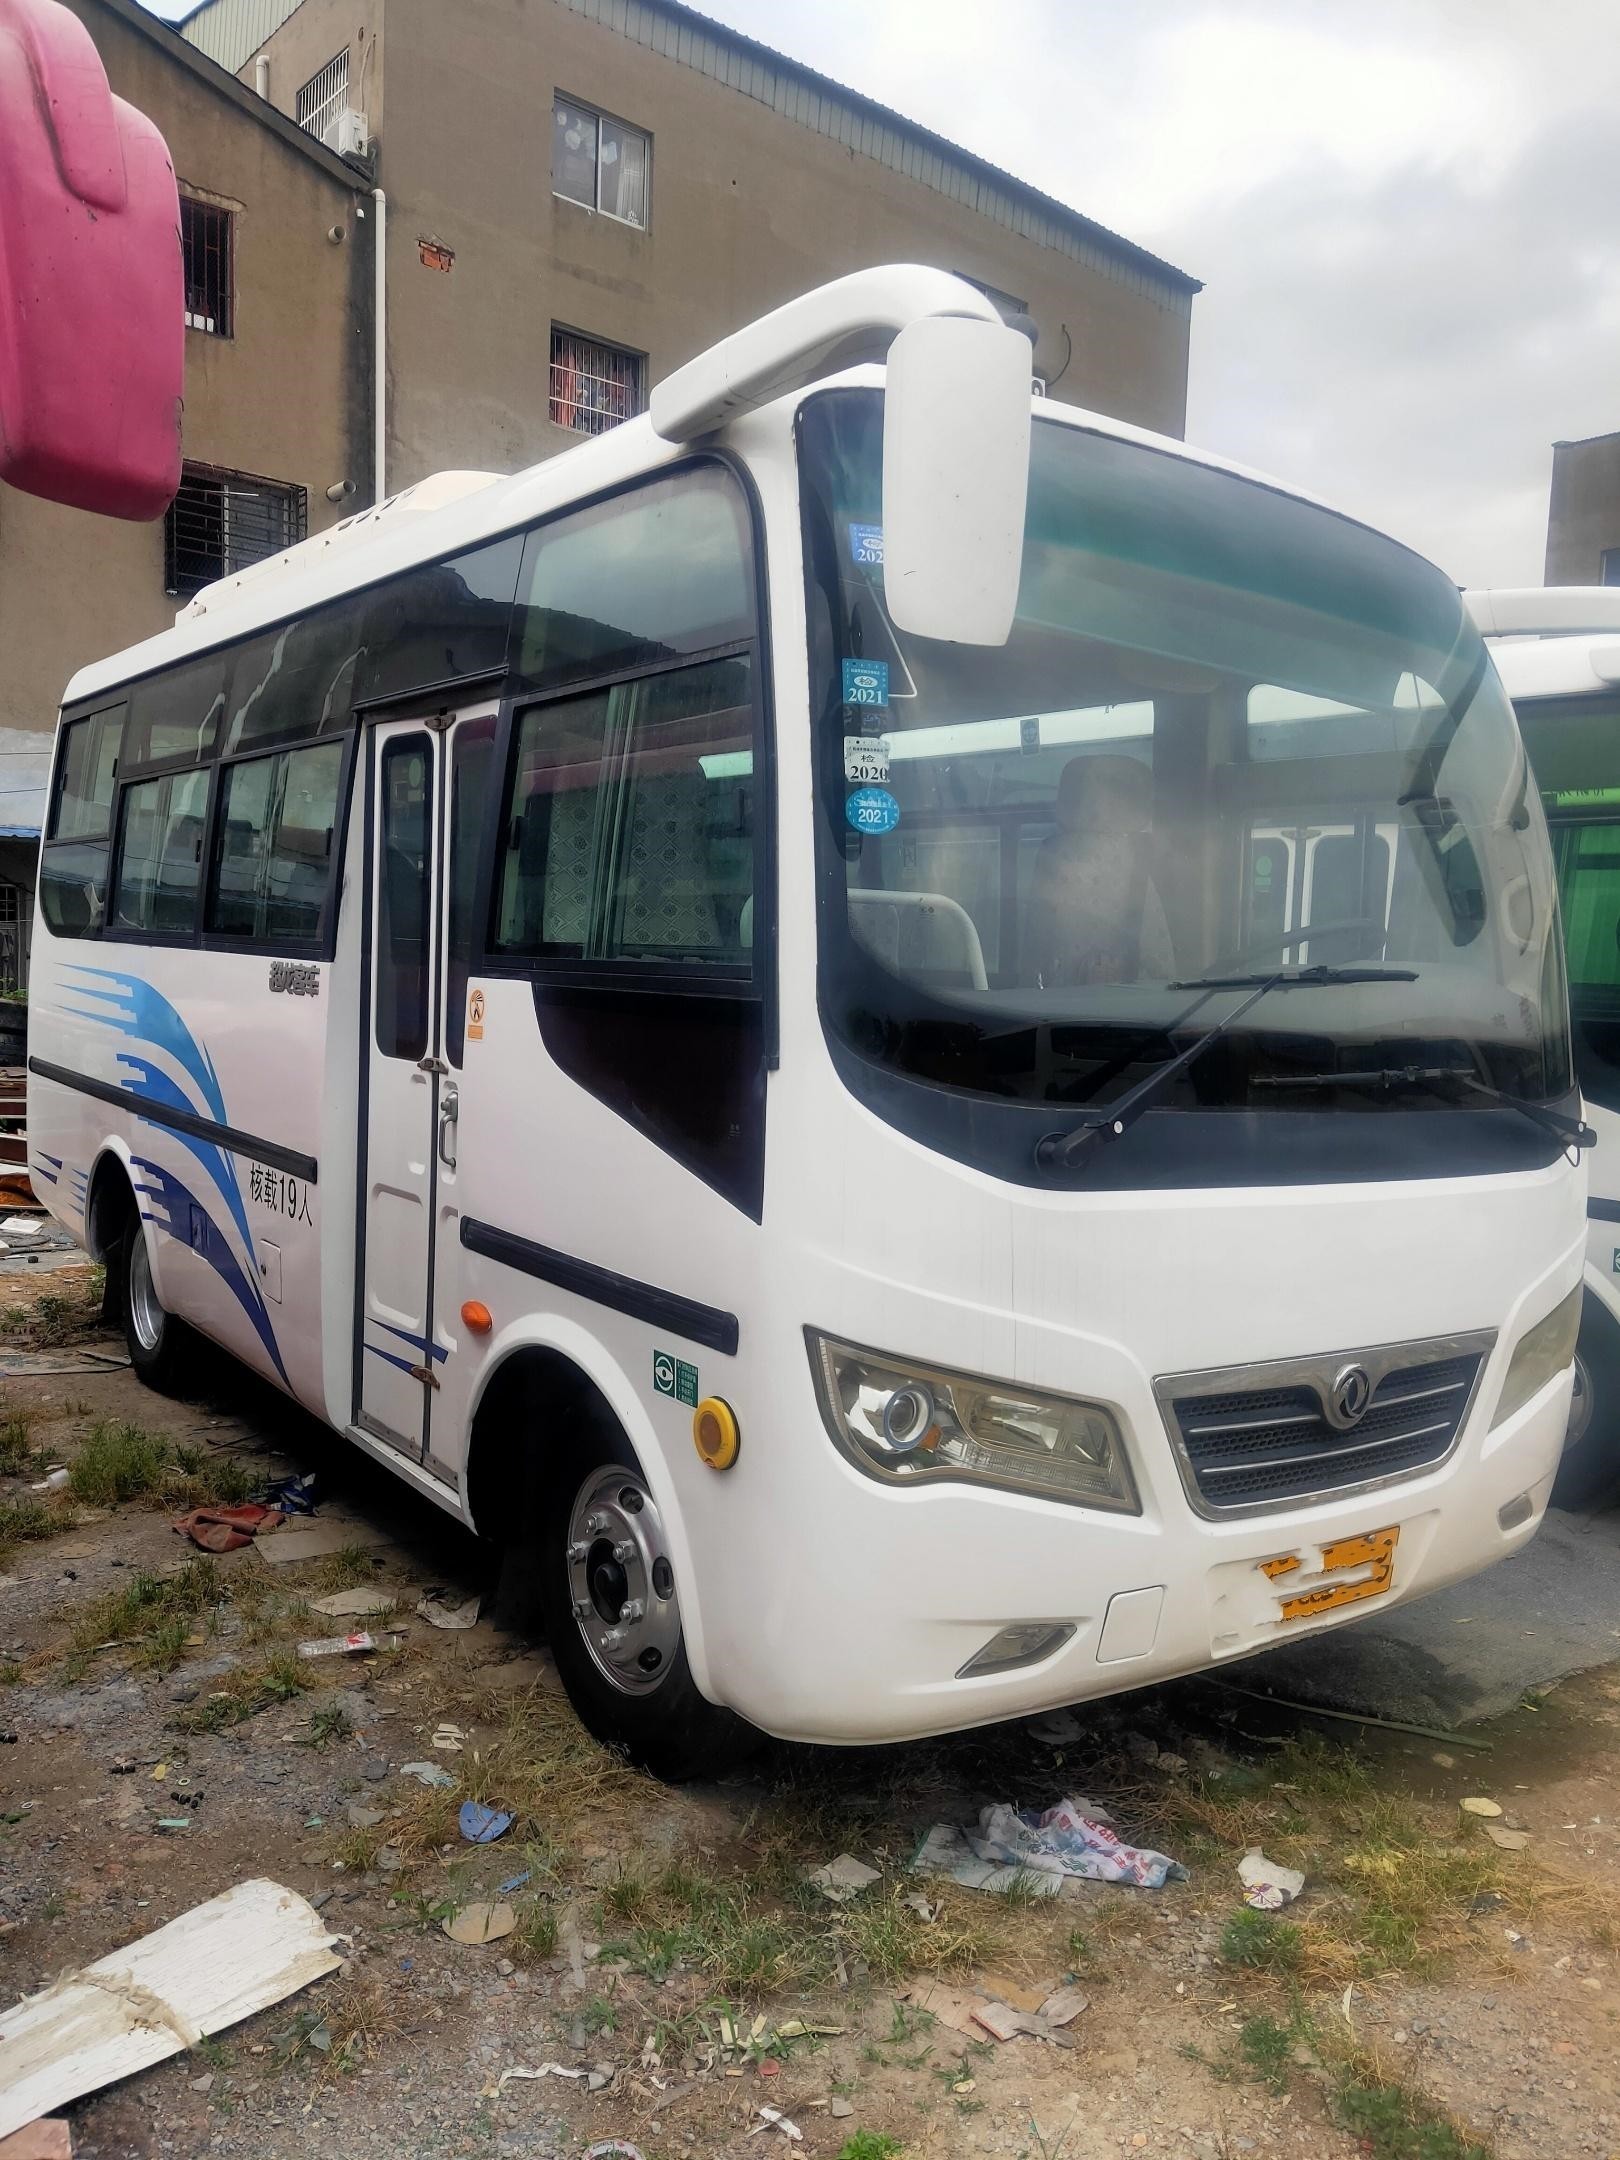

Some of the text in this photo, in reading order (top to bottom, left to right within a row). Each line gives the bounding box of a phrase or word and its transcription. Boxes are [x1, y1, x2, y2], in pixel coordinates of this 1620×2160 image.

[857, 548, 884, 563] 202
[848, 687, 882, 704] 2021
[861, 755, 875, 763] 检
[858, 808, 888, 824] 2021
[250, 1162, 312, 1226] 核载19人
